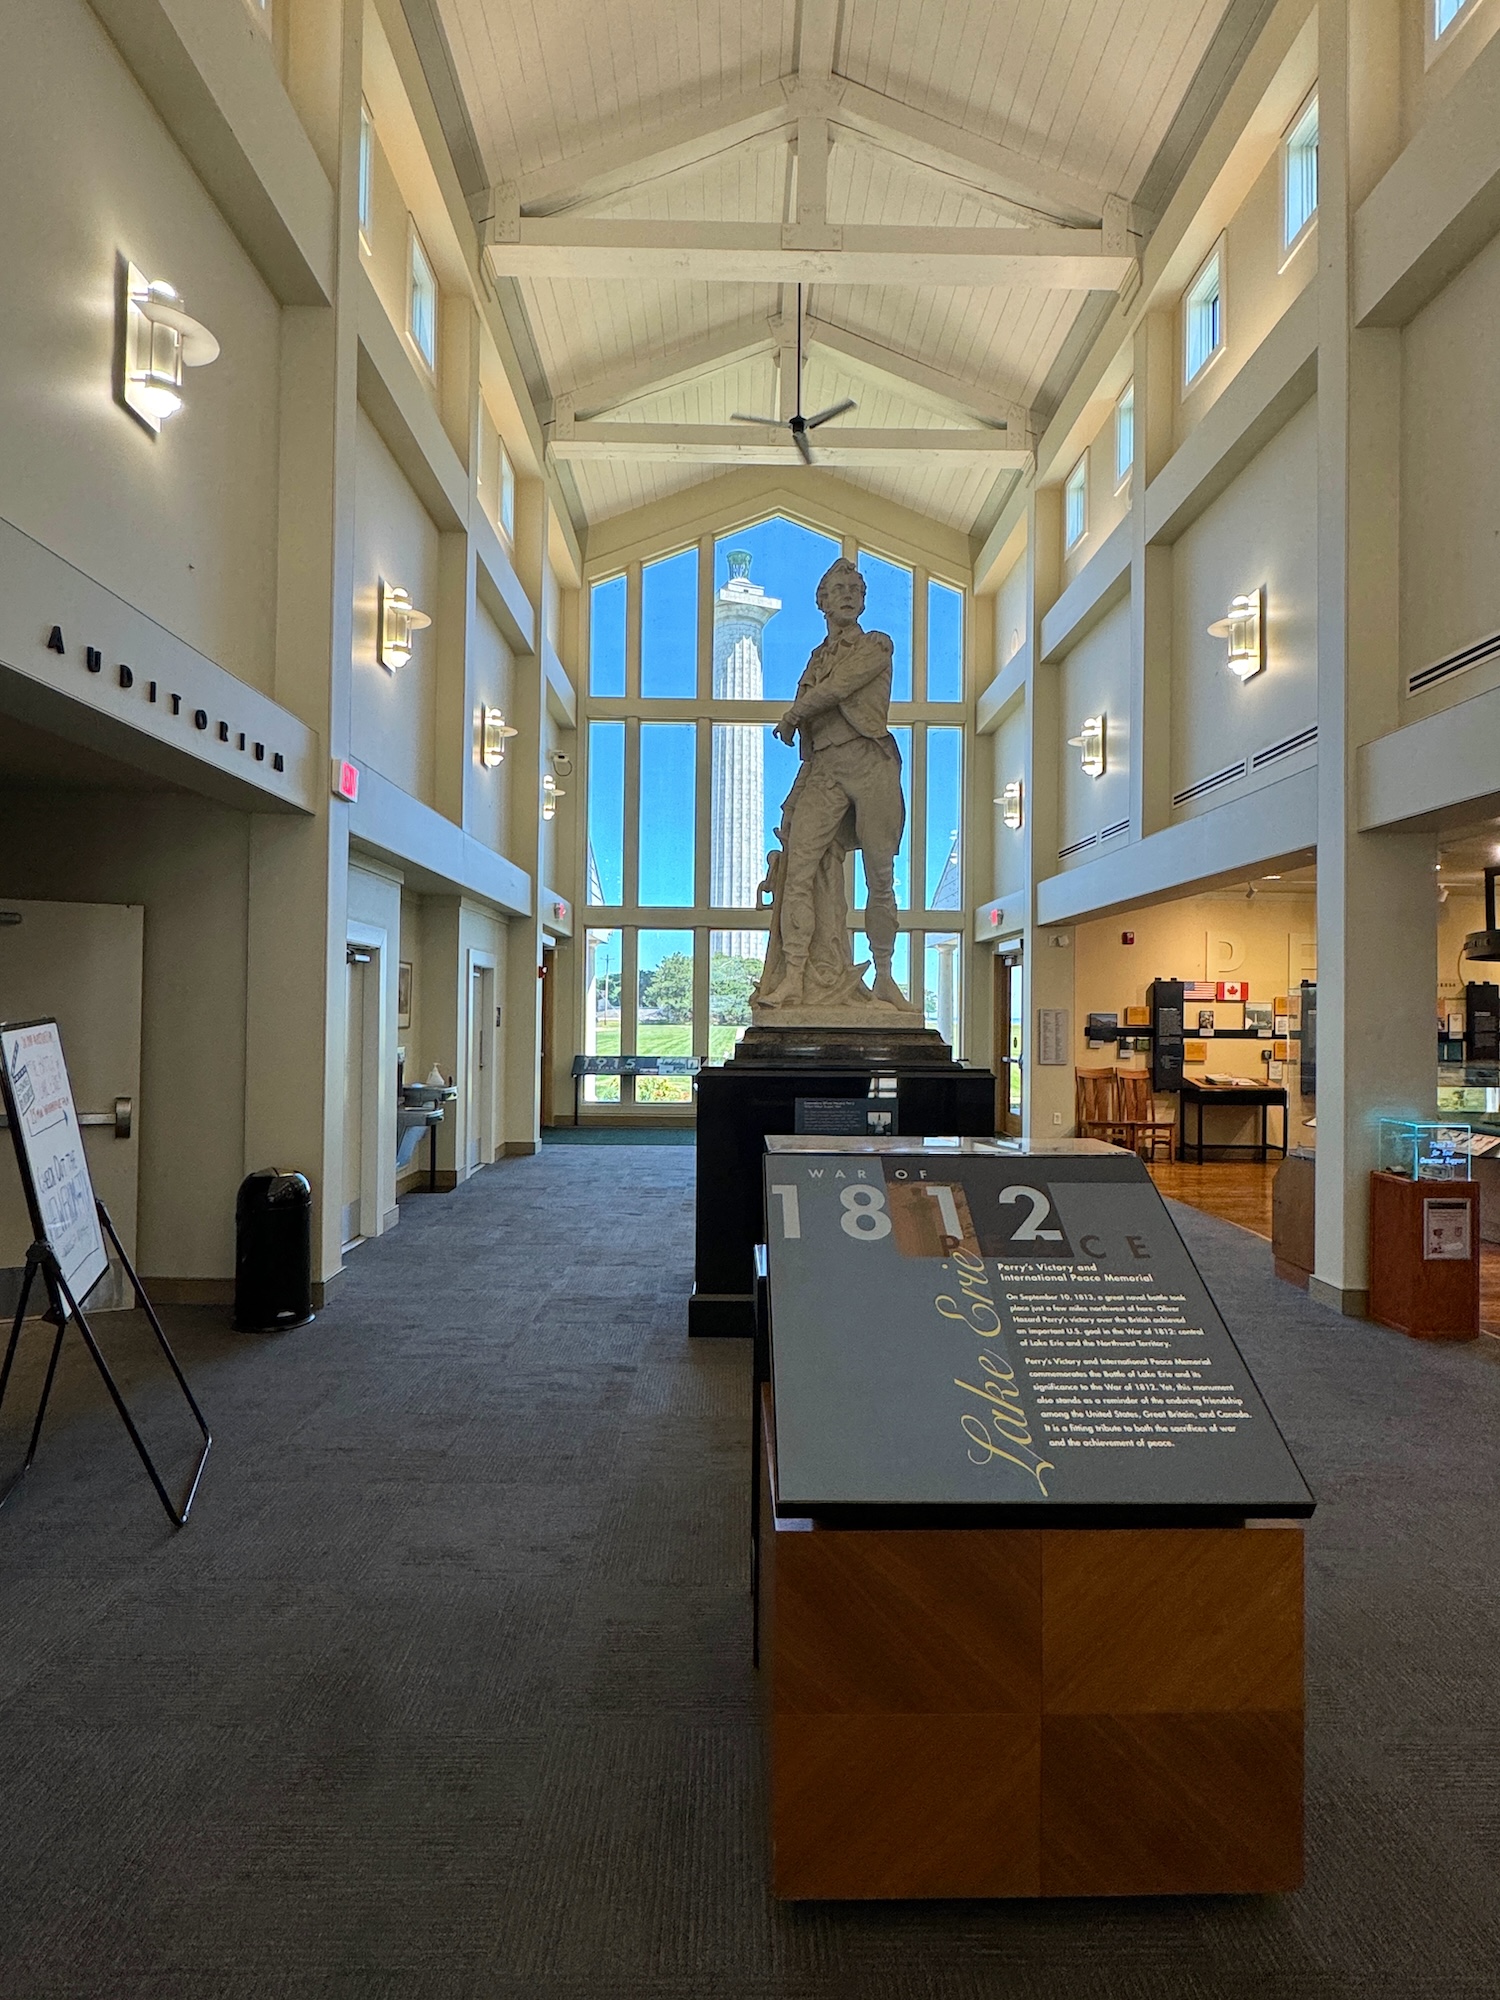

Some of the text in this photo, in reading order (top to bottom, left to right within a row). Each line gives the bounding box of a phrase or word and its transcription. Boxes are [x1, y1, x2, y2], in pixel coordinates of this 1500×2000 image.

[47, 625, 284, 772] AUDITORIUM
[584, 1057, 637, 1070] 1915
[808, 1168, 928, 1180] WAR OF
[771, 1184, 1063, 1241] 1812
[997, 1262, 1098, 1273] Perry's Victory and
[1000, 1273, 1154, 1283] International Peace Memorial
[1006, 1293, 1019, 1301] On
[1019, 1293, 1058, 1301] September
[1060, 1293, 1073, 1302] 10,
[1104, 1294, 1125, 1302] great
[1148, 1293, 1169, 1301] battle
[1169, 1294, 1187, 1302] took
[1009, 1305, 1030, 1313] place
[1031, 1305, 1045, 1313] just
[1042, 1316, 1068, 1325] Perry's
[1069, 1316, 1095, 1325] victory
[1114, 1316, 1127, 1324] the
[1128, 1315, 1152, 1323] British
[1152, 1316, 1187, 1324] achieved
[1028, 1327, 1066, 1336] important
[1066, 1327, 1083, 1335] U.S.
[1083, 1327, 1101, 1336] goal
[1125, 1328, 1142, 1336] War
[1144, 1328, 1153, 1336] of
[1154, 1328, 1177, 1336] 1812:
[1178, 1328, 1205, 1336] control
[1019, 1339, 1029, 1347] of
[1029, 1339, 1048, 1347] Lake
[1049, 1339, 1064, 1347] Erie
[1065, 1339, 1082, 1347] and
[1096, 1339, 1136, 1347] Northwest
[1137, 1340, 1172, 1349] Territory.
[1024, 1357, 1212, 1366] Perry's Victory and International Peace Memorial
[934, 1246, 1055, 1498] Lake Erie
[1088, 1370, 1102, 1378] the
[1102, 1370, 1126, 1378] Battle
[1127, 1370, 1136, 1378] of
[1137, 1370, 1156, 1378] Lake
[1157, 1370, 1173, 1378] Erie
[1174, 1370, 1190, 1378] and
[1191, 1370, 1202, 1379] its
[1033, 1383, 1079, 1392] significance
[1089, 1383, 1103, 1391] the
[1103, 1383, 1122, 1391] War
[1123, 1383, 1133, 1391] of
[1135, 1383, 1159, 1391] 1812.
[1159, 1383, 1175, 1392] Yet,
[1176, 1383, 1192, 1392] this
[1192, 1384, 1235, 1392] monument
[1036, 1396, 1054, 1404] also
[1055, 1396, 1082, 1405] stands
[1102, 1396, 1139, 1405] reminder
[1140, 1396, 1150, 1405] of
[1150, 1396, 1164, 1405] the
[1165, 1396, 1203, 1406] enduring
[1202, 1396, 1244, 1406] friendship
[1040, 1409, 1253, 1420] among the United States, Great Britain, and Canada.
[1044, 1424, 1051, 1432] It
[1052, 1424, 1060, 1432] is
[1069, 1424, 1095, 1434] fitting
[1095, 1424, 1122, 1433] tribute
[1123, 1424, 1133, 1433] to
[1133, 1424, 1154, 1433] both
[1154, 1424, 1169, 1433] the
[1170, 1424, 1208, 1433] sacrifices
[1208, 1424, 1218, 1433] of
[1218, 1425, 1236, 1433] war
[1048, 1438, 1175, 1449] and the achievement of peace.
